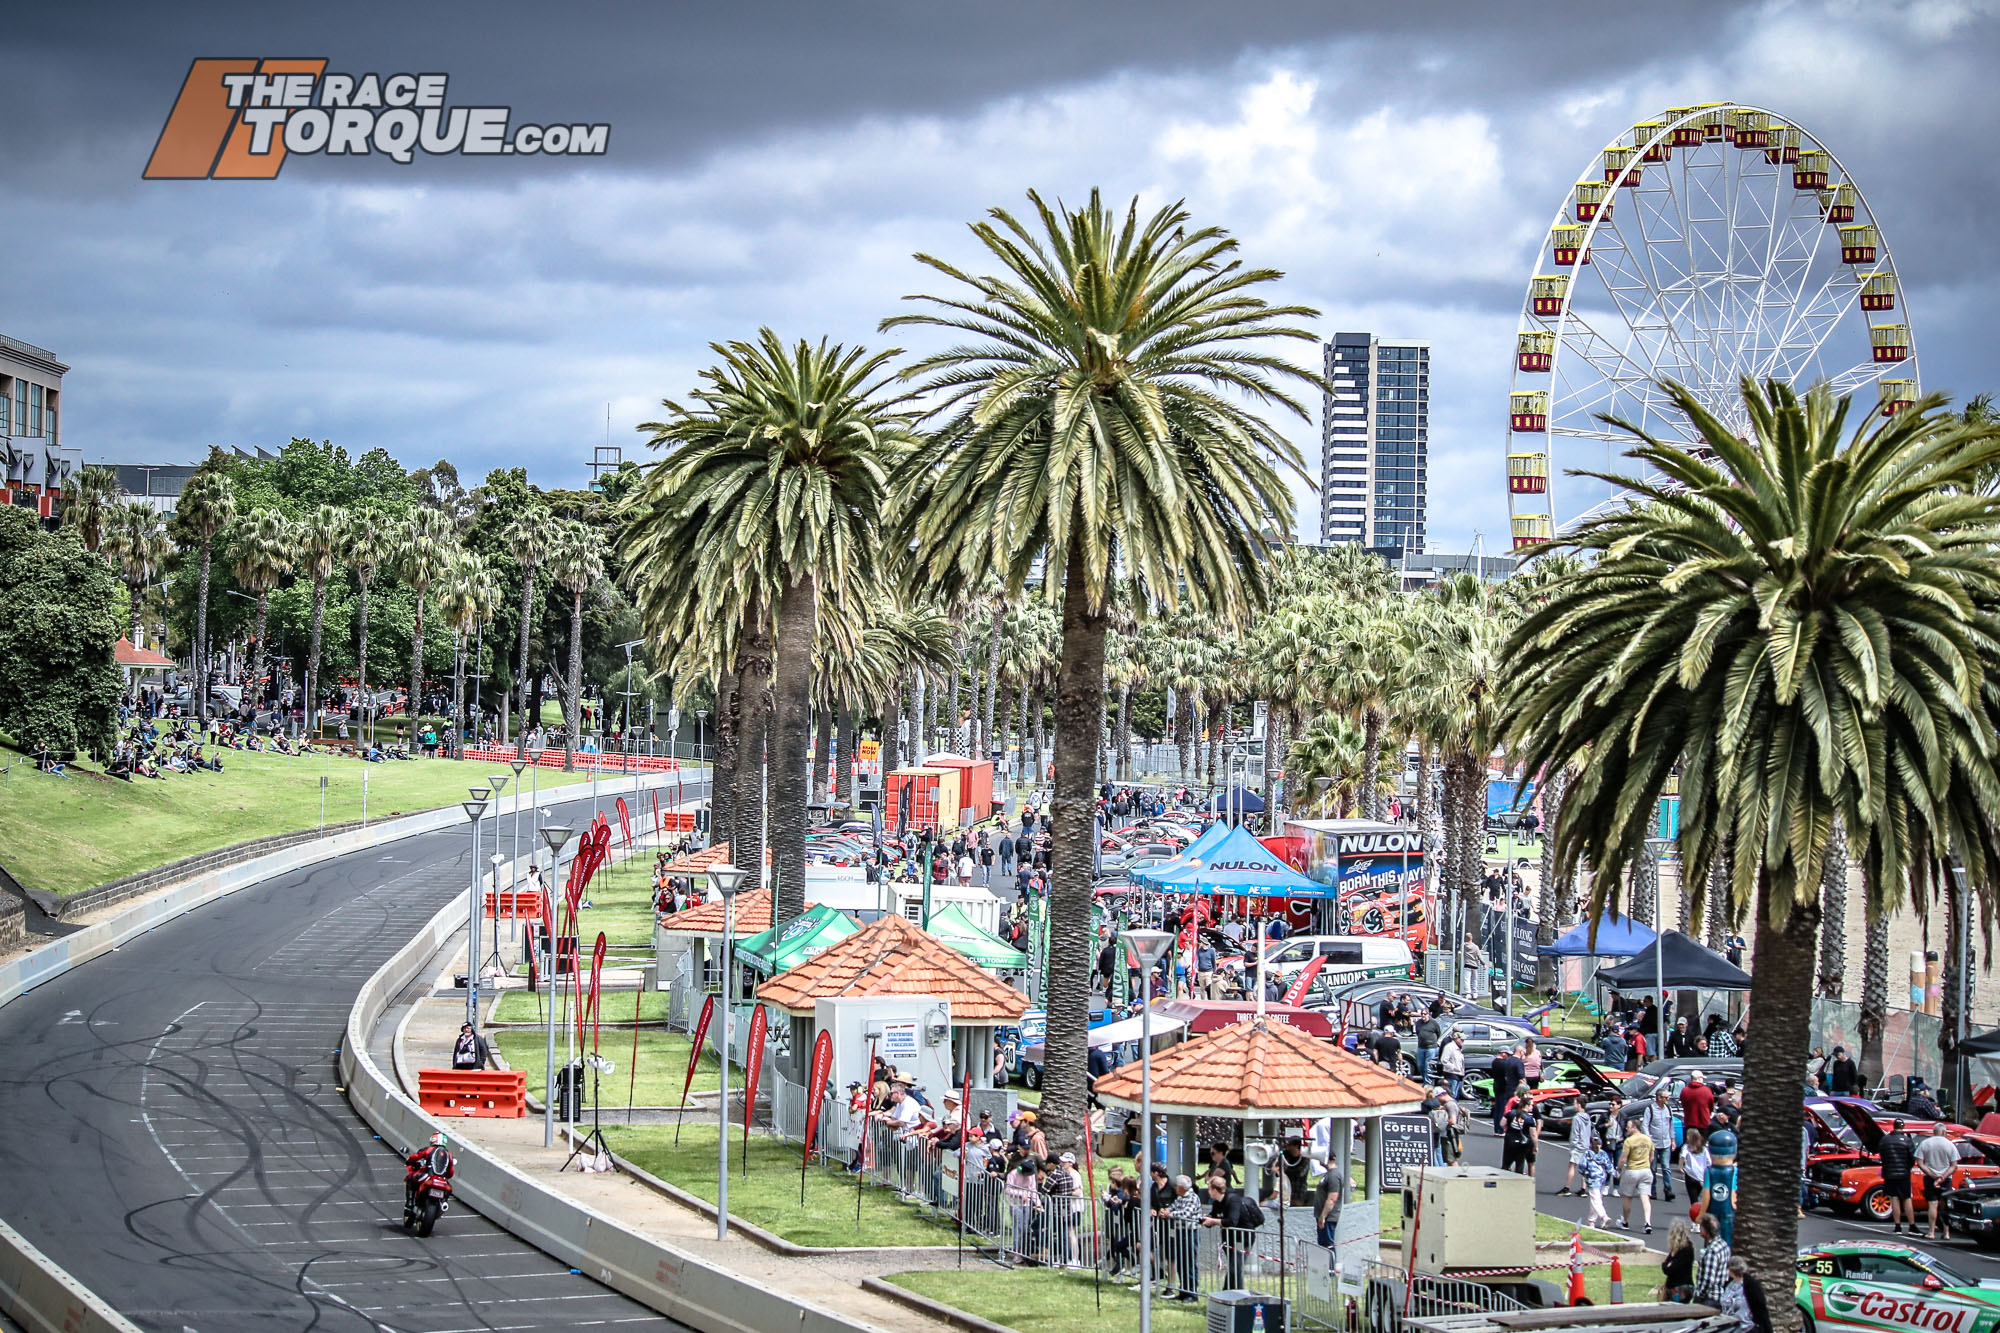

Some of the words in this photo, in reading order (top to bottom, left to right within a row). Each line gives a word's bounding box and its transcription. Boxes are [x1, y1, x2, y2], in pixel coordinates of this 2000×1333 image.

[1340, 834, 1422, 853] NULON
[1209, 860, 1279, 873] NULON
[1340, 872, 1370, 894] BORN
[1371, 869, 1396, 888] THIS
[817, 1039, 827, 1075] REVIVAL
[1384, 1124, 1428, 1134] COFFEE
[1816, 1260, 1833, 1274] 55
[1845, 1270, 1873, 1281] Randle
[1860, 1291, 1967, 1333] Castrol
